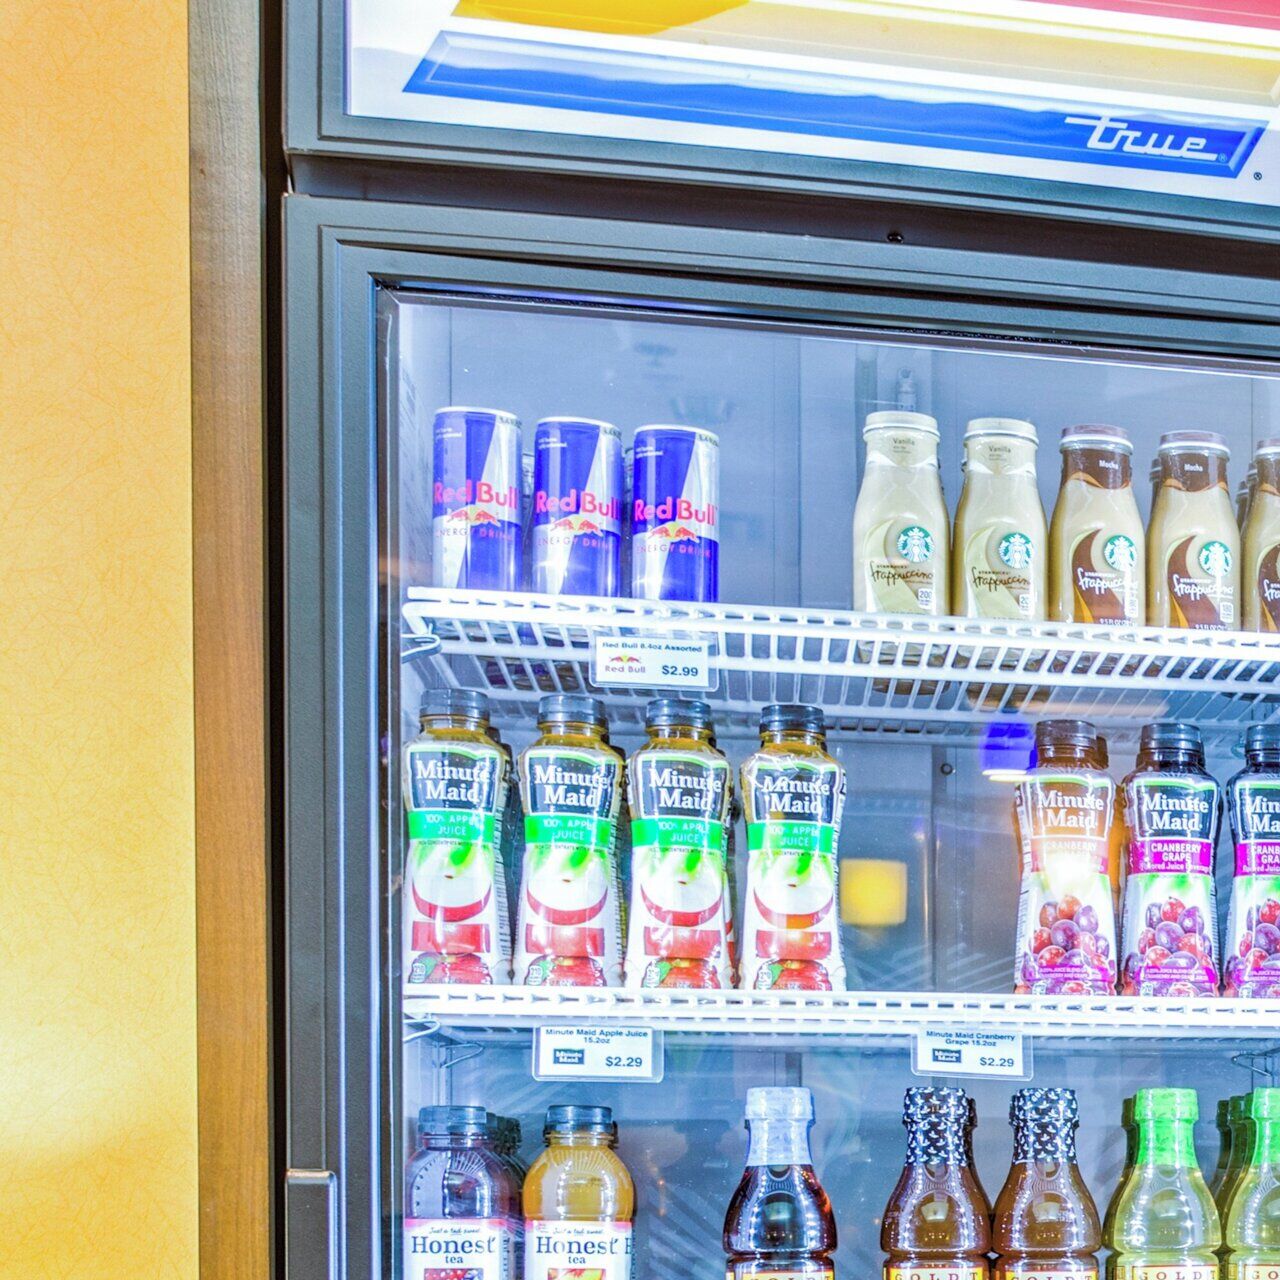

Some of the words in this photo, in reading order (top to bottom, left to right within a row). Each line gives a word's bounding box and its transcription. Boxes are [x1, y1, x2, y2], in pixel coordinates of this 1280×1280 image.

[893, 438, 915, 446] Vanilla
[989, 445, 1011, 454] Vanilla
[1099, 459, 1119, 470] Mocha
[1185, 464, 1203, 472] Mocha
[434, 480, 472, 504] Red
[476, 482, 517, 510] Bull
[535, 489, 576, 514] Red
[581, 492, 619, 520] Bull
[635, 497, 672, 521] Red
[677, 499, 716, 525] Bull
[662, 665, 699, 676] $2.99
[416, 760, 491, 784] Minute
[534, 765, 608, 789] Minute
[649, 768, 722, 794] Minute
[425, 781, 481, 804] Maid
[764, 775, 830, 798] Minute
[544, 786, 599, 808] Maid
[659, 789, 713, 811] Maid
[770, 793, 823, 814] Maid
[1037, 791, 1104, 812] Minute
[1143, 794, 1209, 813] Minute
[1047, 809, 1098, 829] Maid
[1152, 813, 1203, 831] Maid
[1151, 843, 1202, 854] CRANBERRY
[1162, 853, 1191, 862] GRAPE
[545, 1029, 574, 1037] Minute
[576, 1029, 597, 1037] Maid
[599, 1030, 623, 1039] Apple
[975, 1033, 1016, 1042] Cranberry
[605, 1056, 643, 1068] $2.29
[979, 1056, 1015, 1068] $2.29
[411, 1235, 497, 1255] Honest
[536, 1235, 618, 1256] Honest
[445, 1255, 464, 1265] tea
[567, 1255, 586, 1265] tea
